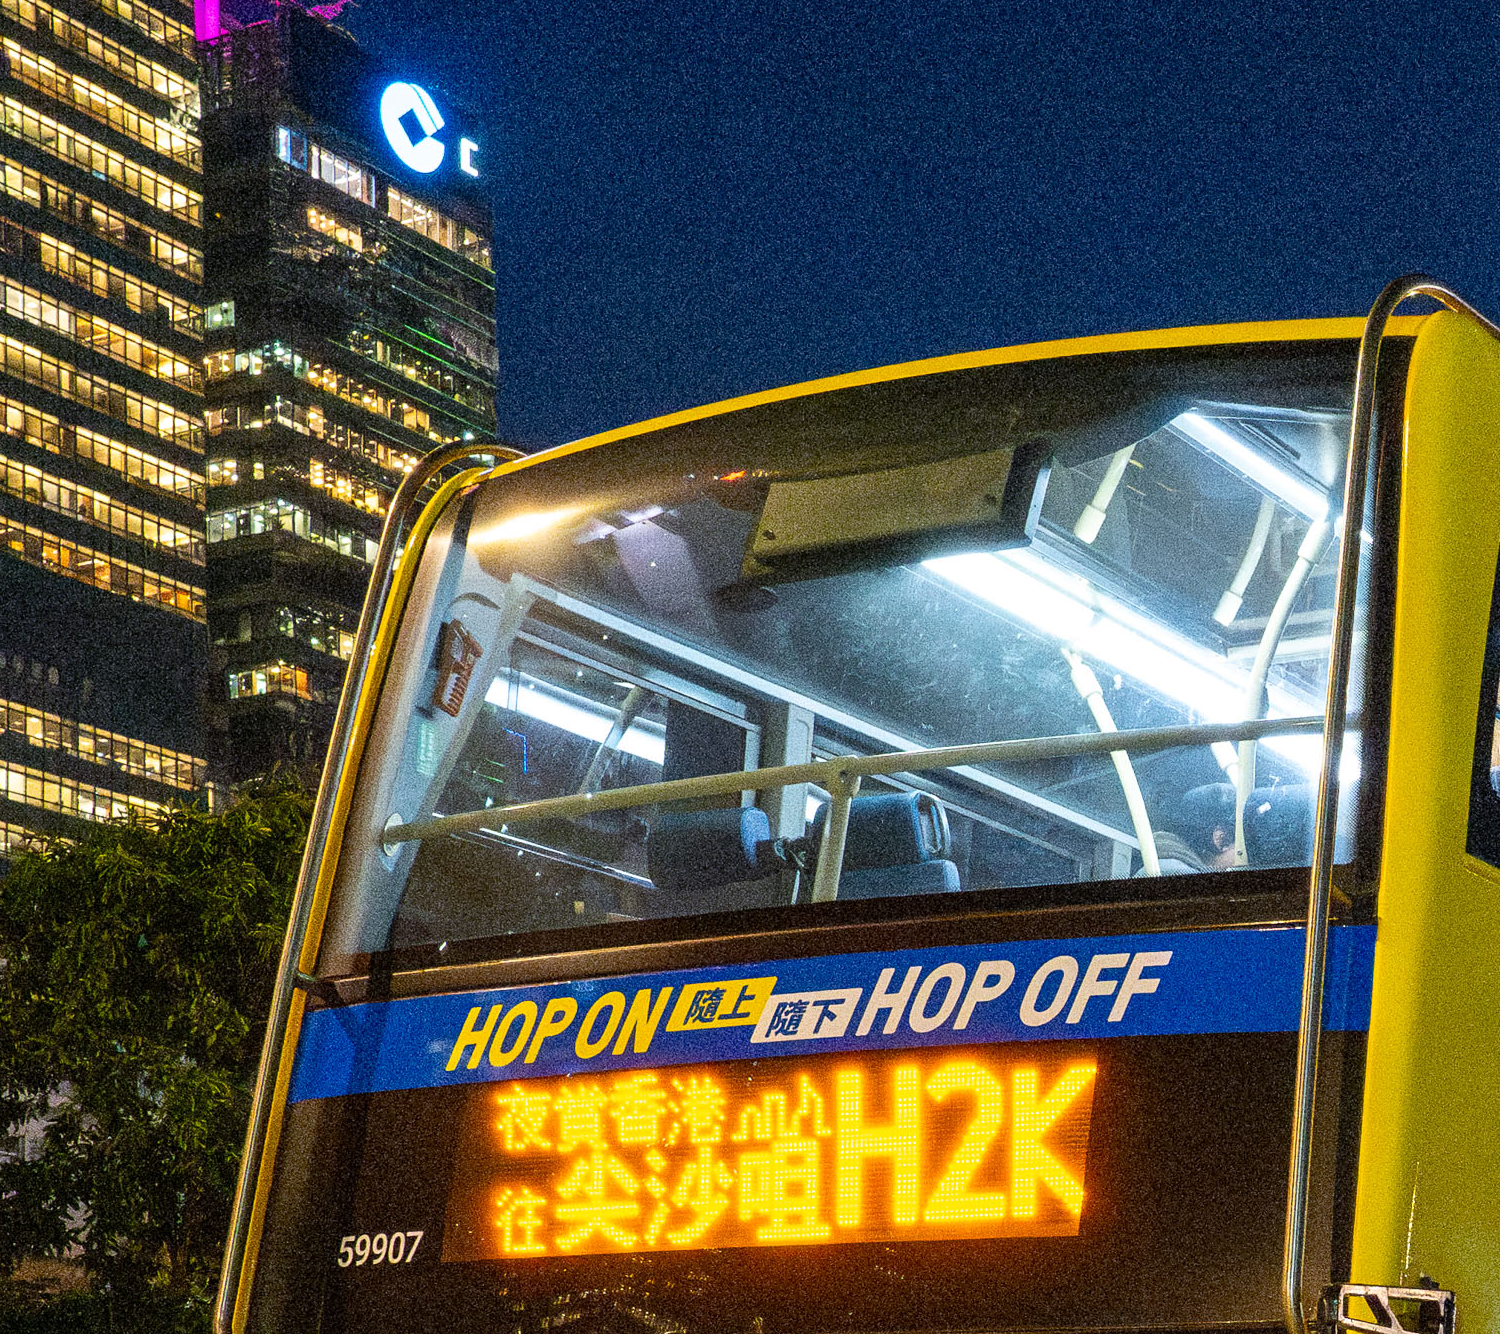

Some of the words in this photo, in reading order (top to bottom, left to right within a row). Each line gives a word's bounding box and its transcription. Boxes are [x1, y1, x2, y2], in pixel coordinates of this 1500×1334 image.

[683, 985, 755, 1026] 隨上
[765, 999, 845, 1038] 隨下
[855, 961, 1017, 1037] HOP
[1019, 951, 1173, 1027] OFF
[445, 998, 579, 1071] HOP
[575, 986, 675, 1059] ON
[835, 1060, 1098, 1229] H2K
[337, 1229, 425, 1269] 59907
